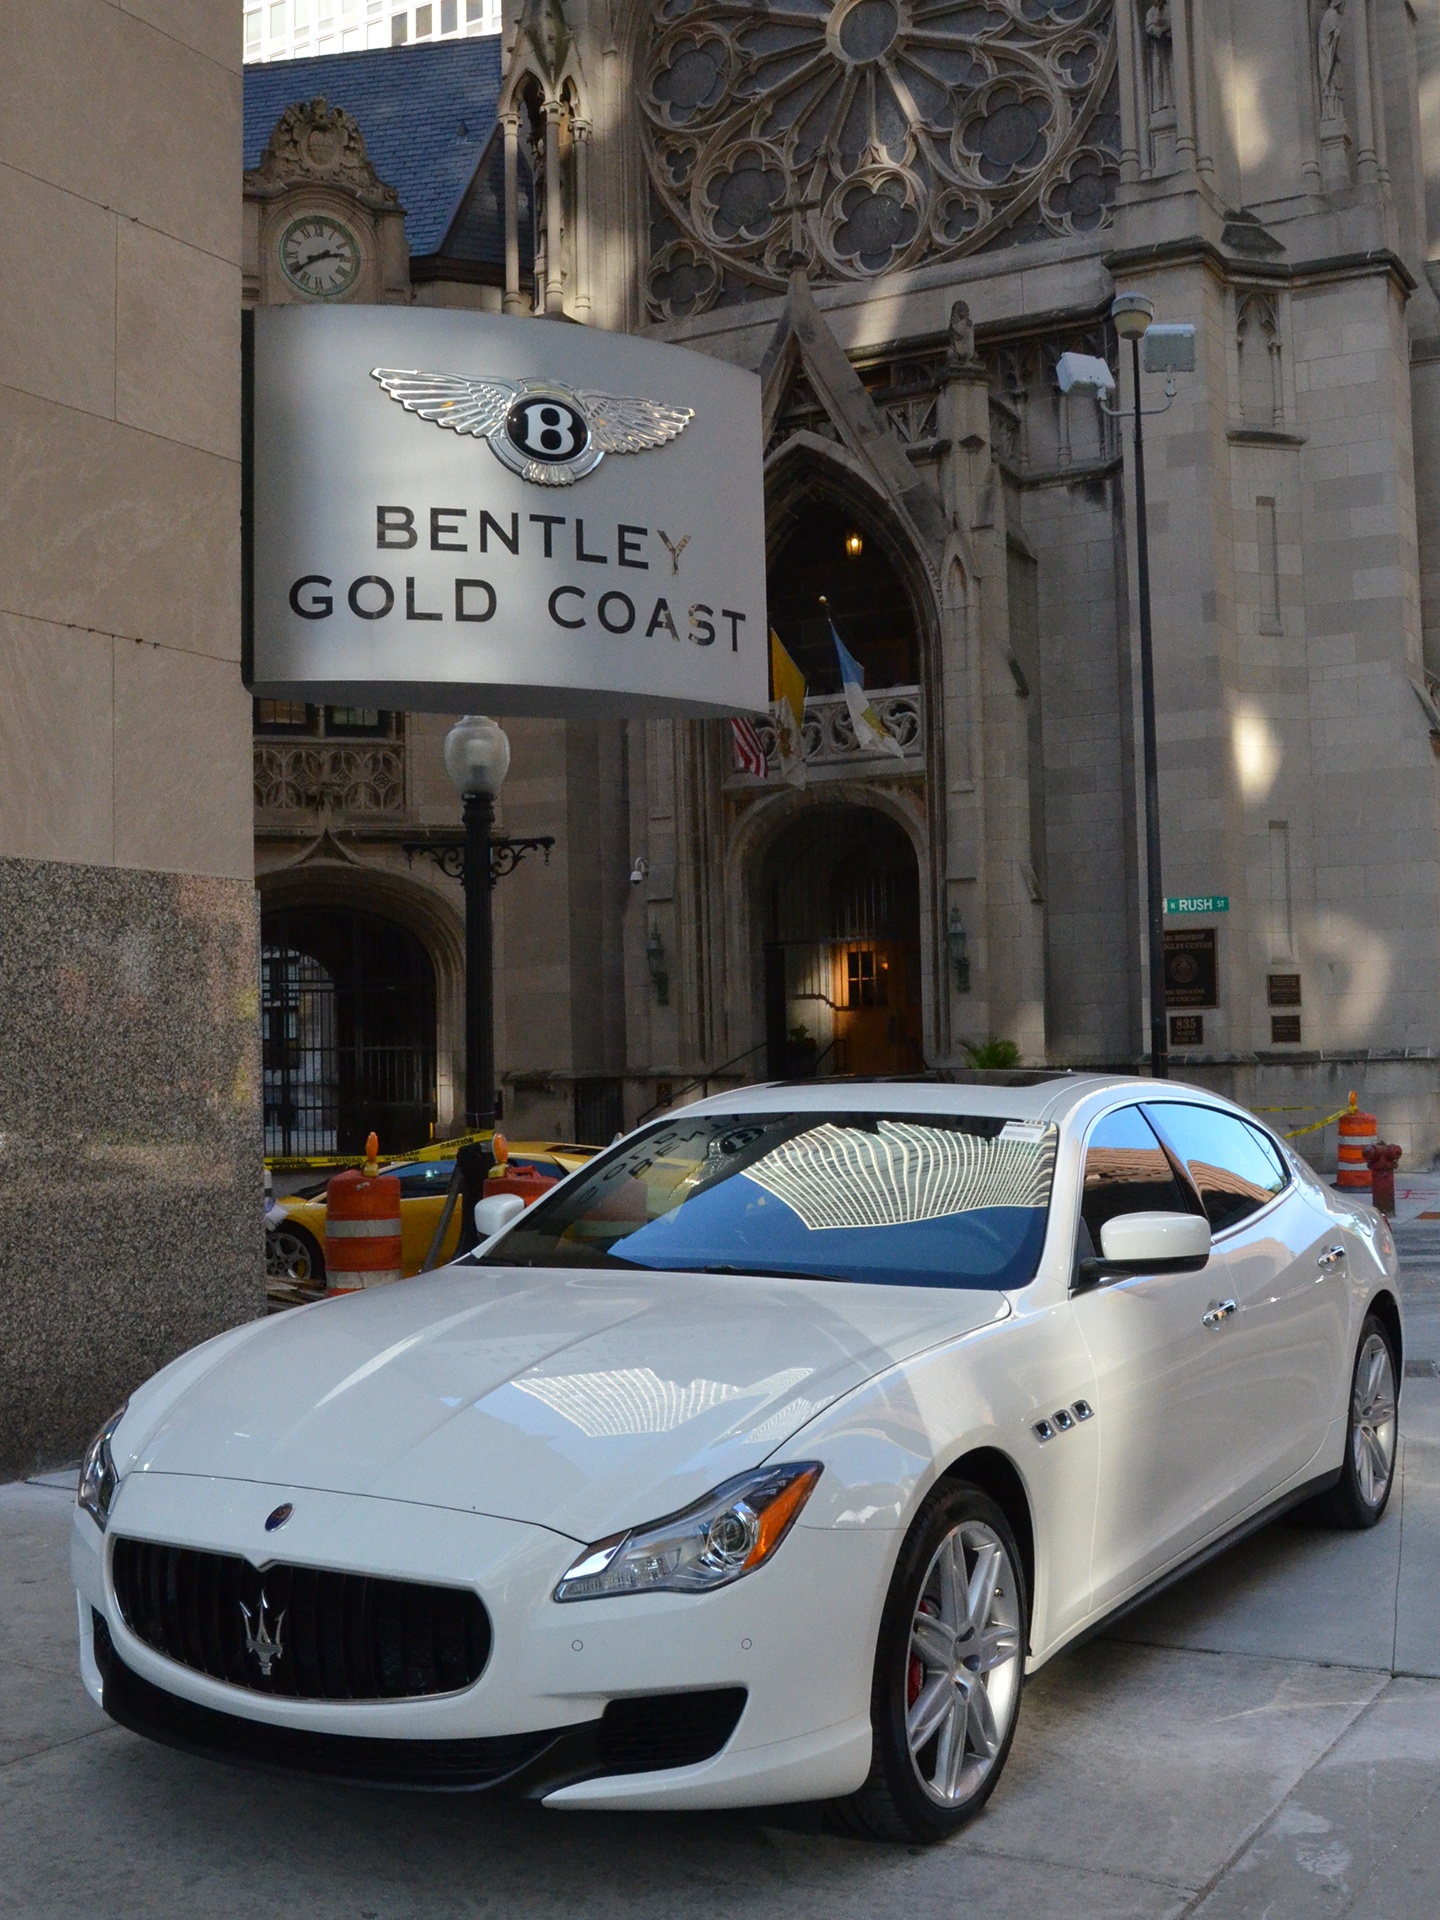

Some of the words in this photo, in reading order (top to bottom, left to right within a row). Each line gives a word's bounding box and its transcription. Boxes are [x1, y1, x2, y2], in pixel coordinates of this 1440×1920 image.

[525, 403, 575, 455] B
[376, 505, 692, 575] BENTLEY
[289, 575, 497, 622] GOLD
[548, 585, 746, 652] COAST
[1179, 898, 1213, 911] RUSH
[1217, 900, 1225, 908] ST
[1176, 1018, 1196, 1030] 835
[440, 1136, 474, 1149] CAUTION
